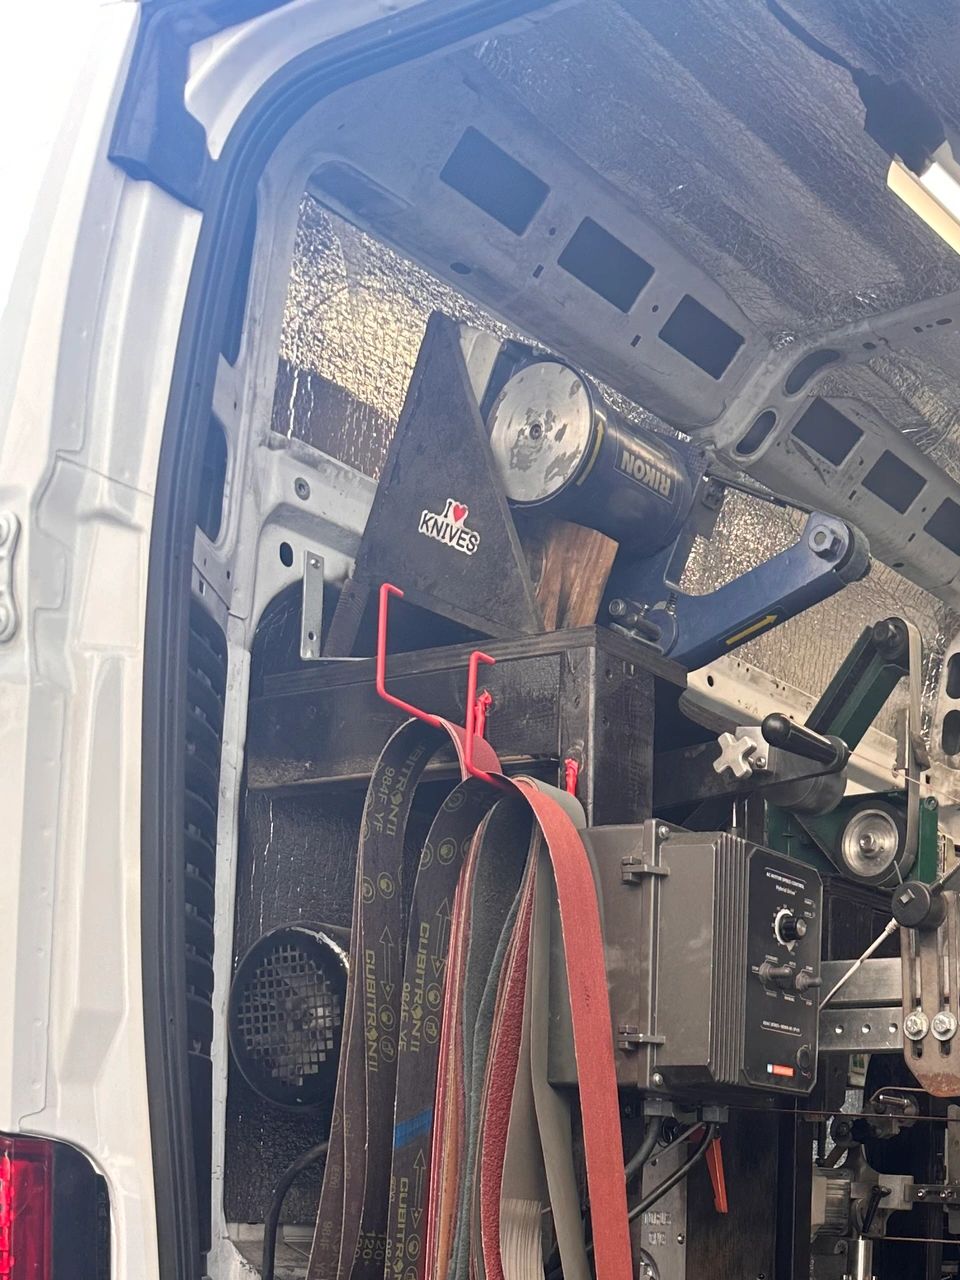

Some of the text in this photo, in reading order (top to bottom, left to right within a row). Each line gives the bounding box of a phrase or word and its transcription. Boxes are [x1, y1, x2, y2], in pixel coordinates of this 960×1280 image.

[621, 450, 671, 497] RIKON
[444, 501, 453, 518] I
[420, 512, 479, 552] KNIVES
[373, 766, 395, 833] 984F YF
